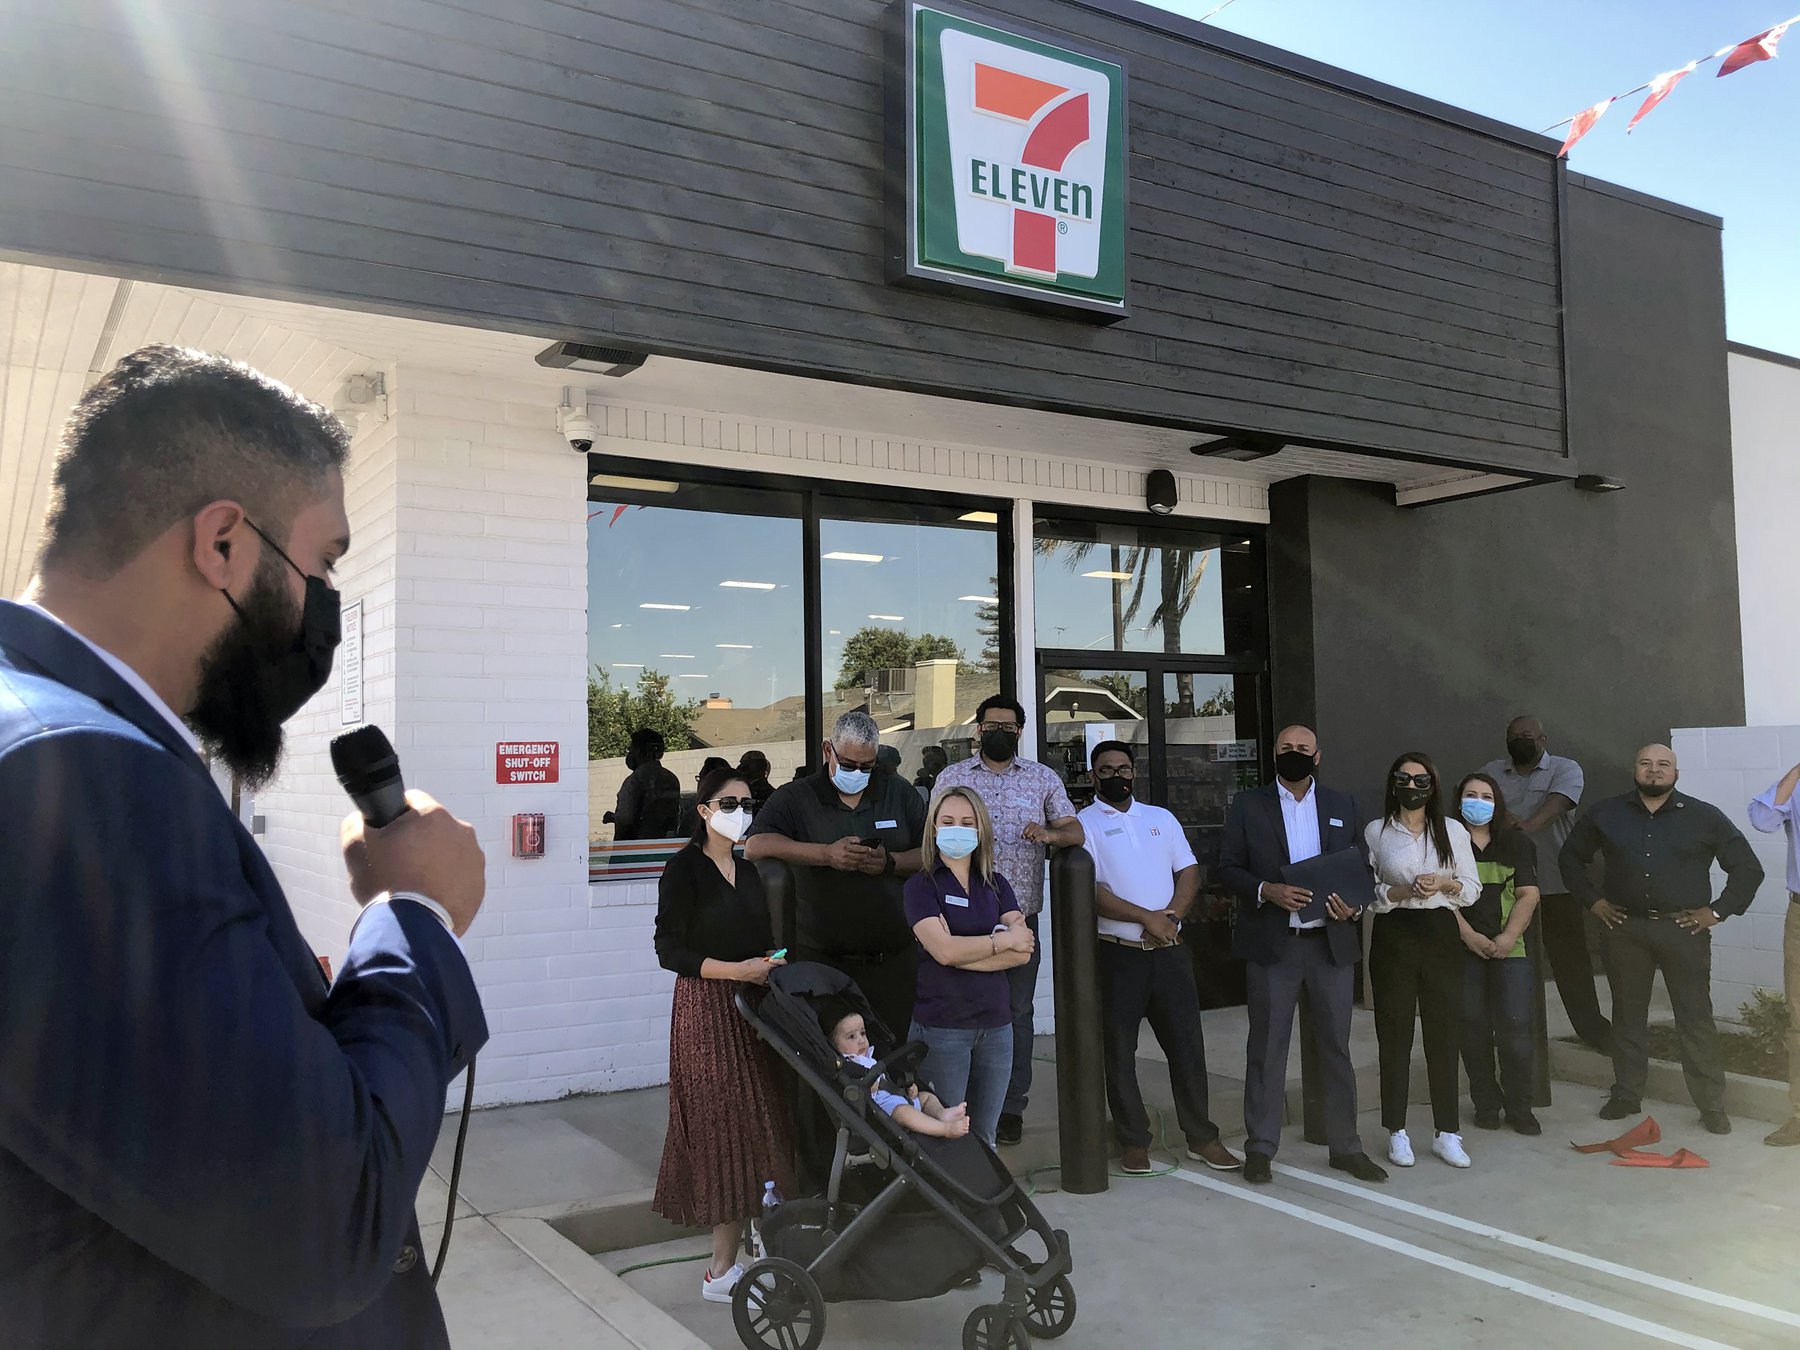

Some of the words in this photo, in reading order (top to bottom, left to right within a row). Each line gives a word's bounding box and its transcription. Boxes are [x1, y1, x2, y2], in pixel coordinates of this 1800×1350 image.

[974, 61, 1090, 274] 7
[499, 744, 556, 755] EMERGENCY
[505, 757, 551, 769] SHUT-OFF
[510, 770, 546, 782] SWITCH
